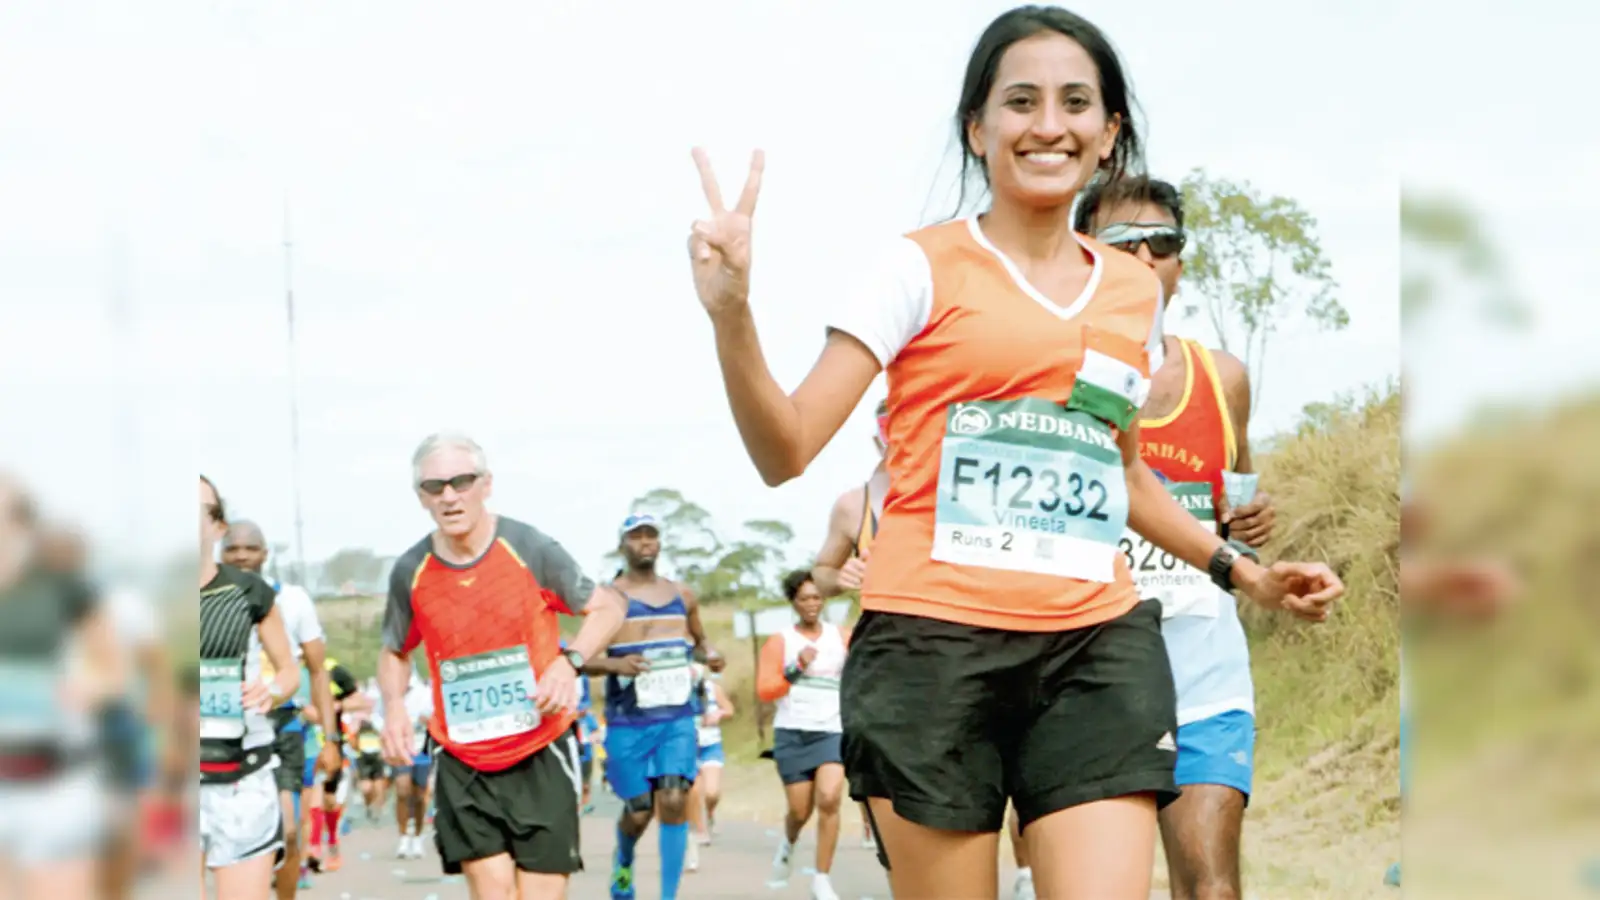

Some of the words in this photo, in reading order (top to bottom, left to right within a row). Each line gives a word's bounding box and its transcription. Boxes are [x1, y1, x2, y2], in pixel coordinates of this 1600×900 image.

[951, 457, 1109, 521] F12332
[1171, 494, 1214, 509] ANK
[993, 508, 1066, 534] Vineeta
[952, 530, 993, 549] Runs
[1000, 531, 1014, 552] 2
[449, 680, 527, 716] F27055
